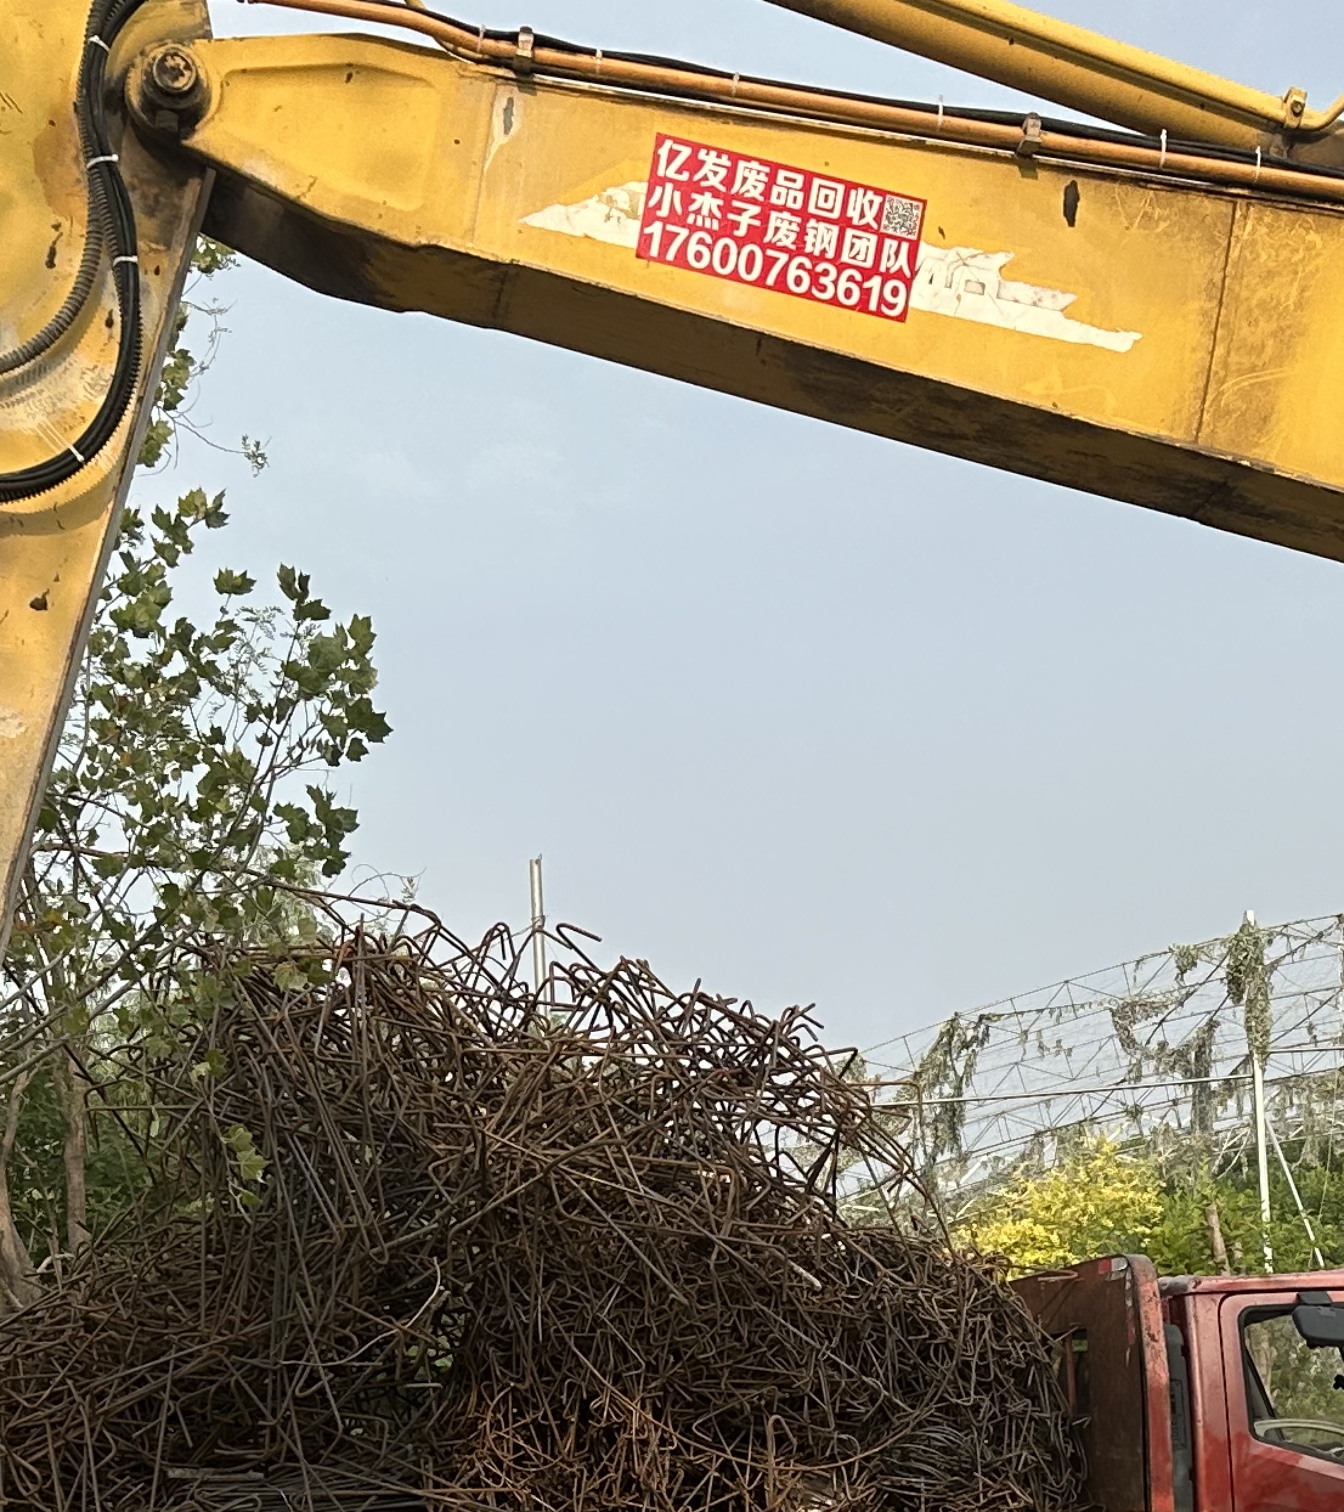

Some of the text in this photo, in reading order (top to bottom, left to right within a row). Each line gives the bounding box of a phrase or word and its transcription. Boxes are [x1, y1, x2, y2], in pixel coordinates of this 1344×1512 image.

[648, 185, 913, 279] 小杰子废钢团队
[657, 139, 883, 231] 亿发废品回收
[642, 220, 908, 318] 17600763619
